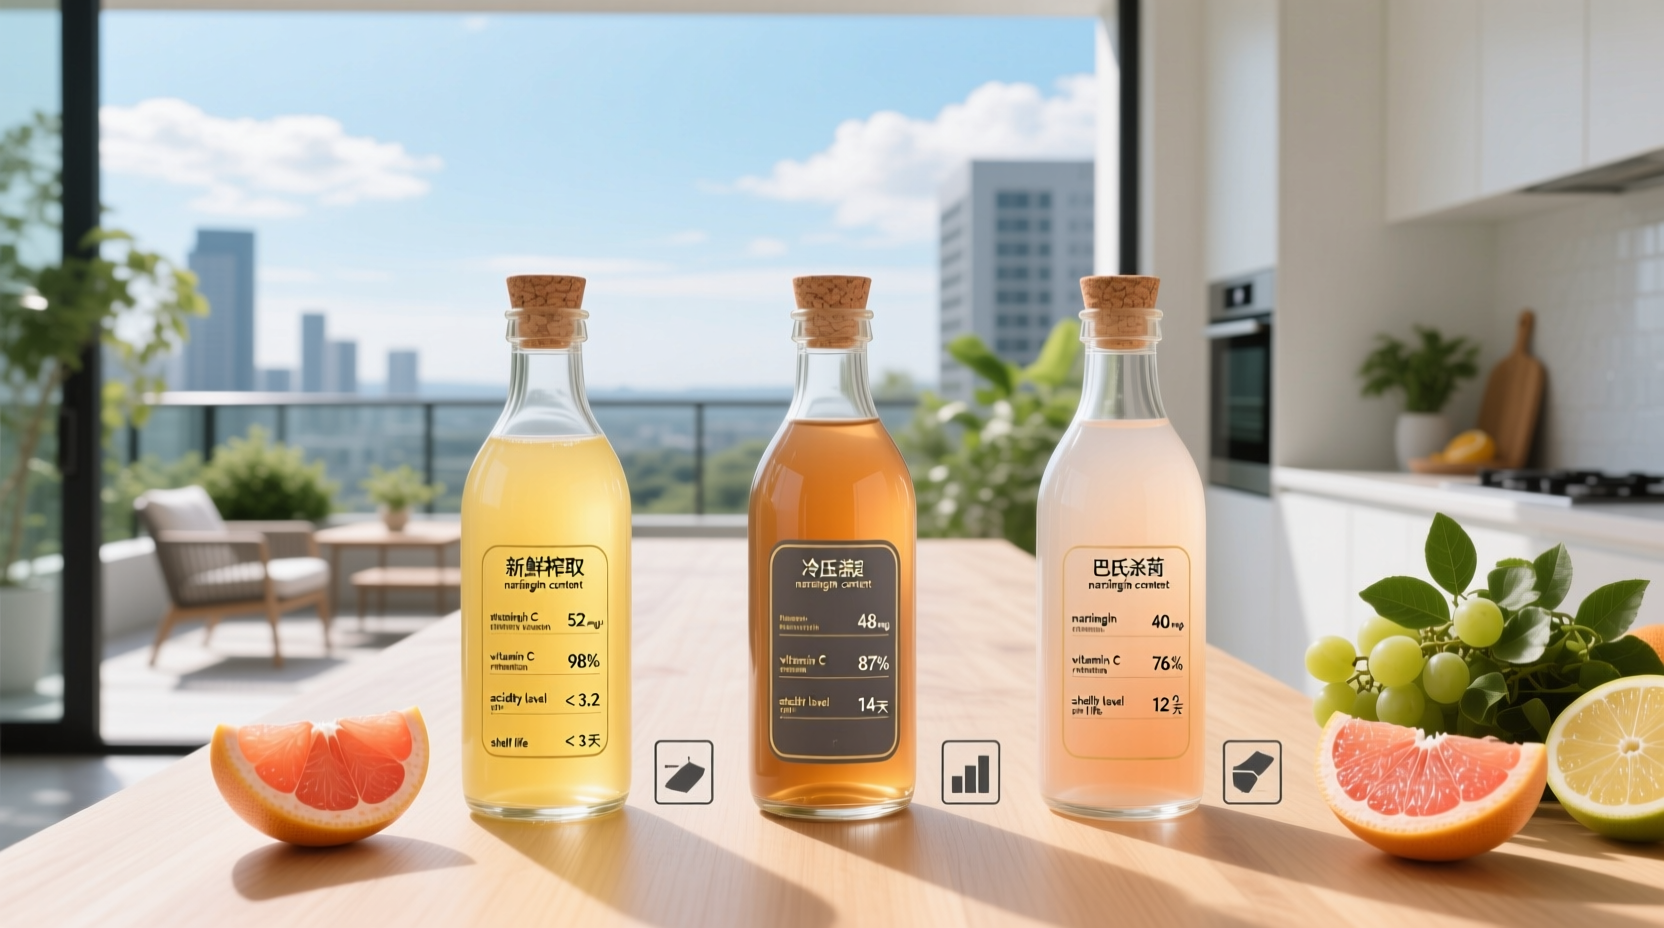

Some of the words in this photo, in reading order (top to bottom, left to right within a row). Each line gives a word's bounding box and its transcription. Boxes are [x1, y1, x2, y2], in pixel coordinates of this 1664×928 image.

[530, 612, 539, 622] C
[526, 651, 535, 662] C
[567, 653, 601, 669] 98%
[818, 654, 827, 666] C
[1112, 654, 1121, 666] C
[858, 655, 890, 671] 87%
[1152, 655, 1184, 671] 76%
[514, 737, 529, 748] life
